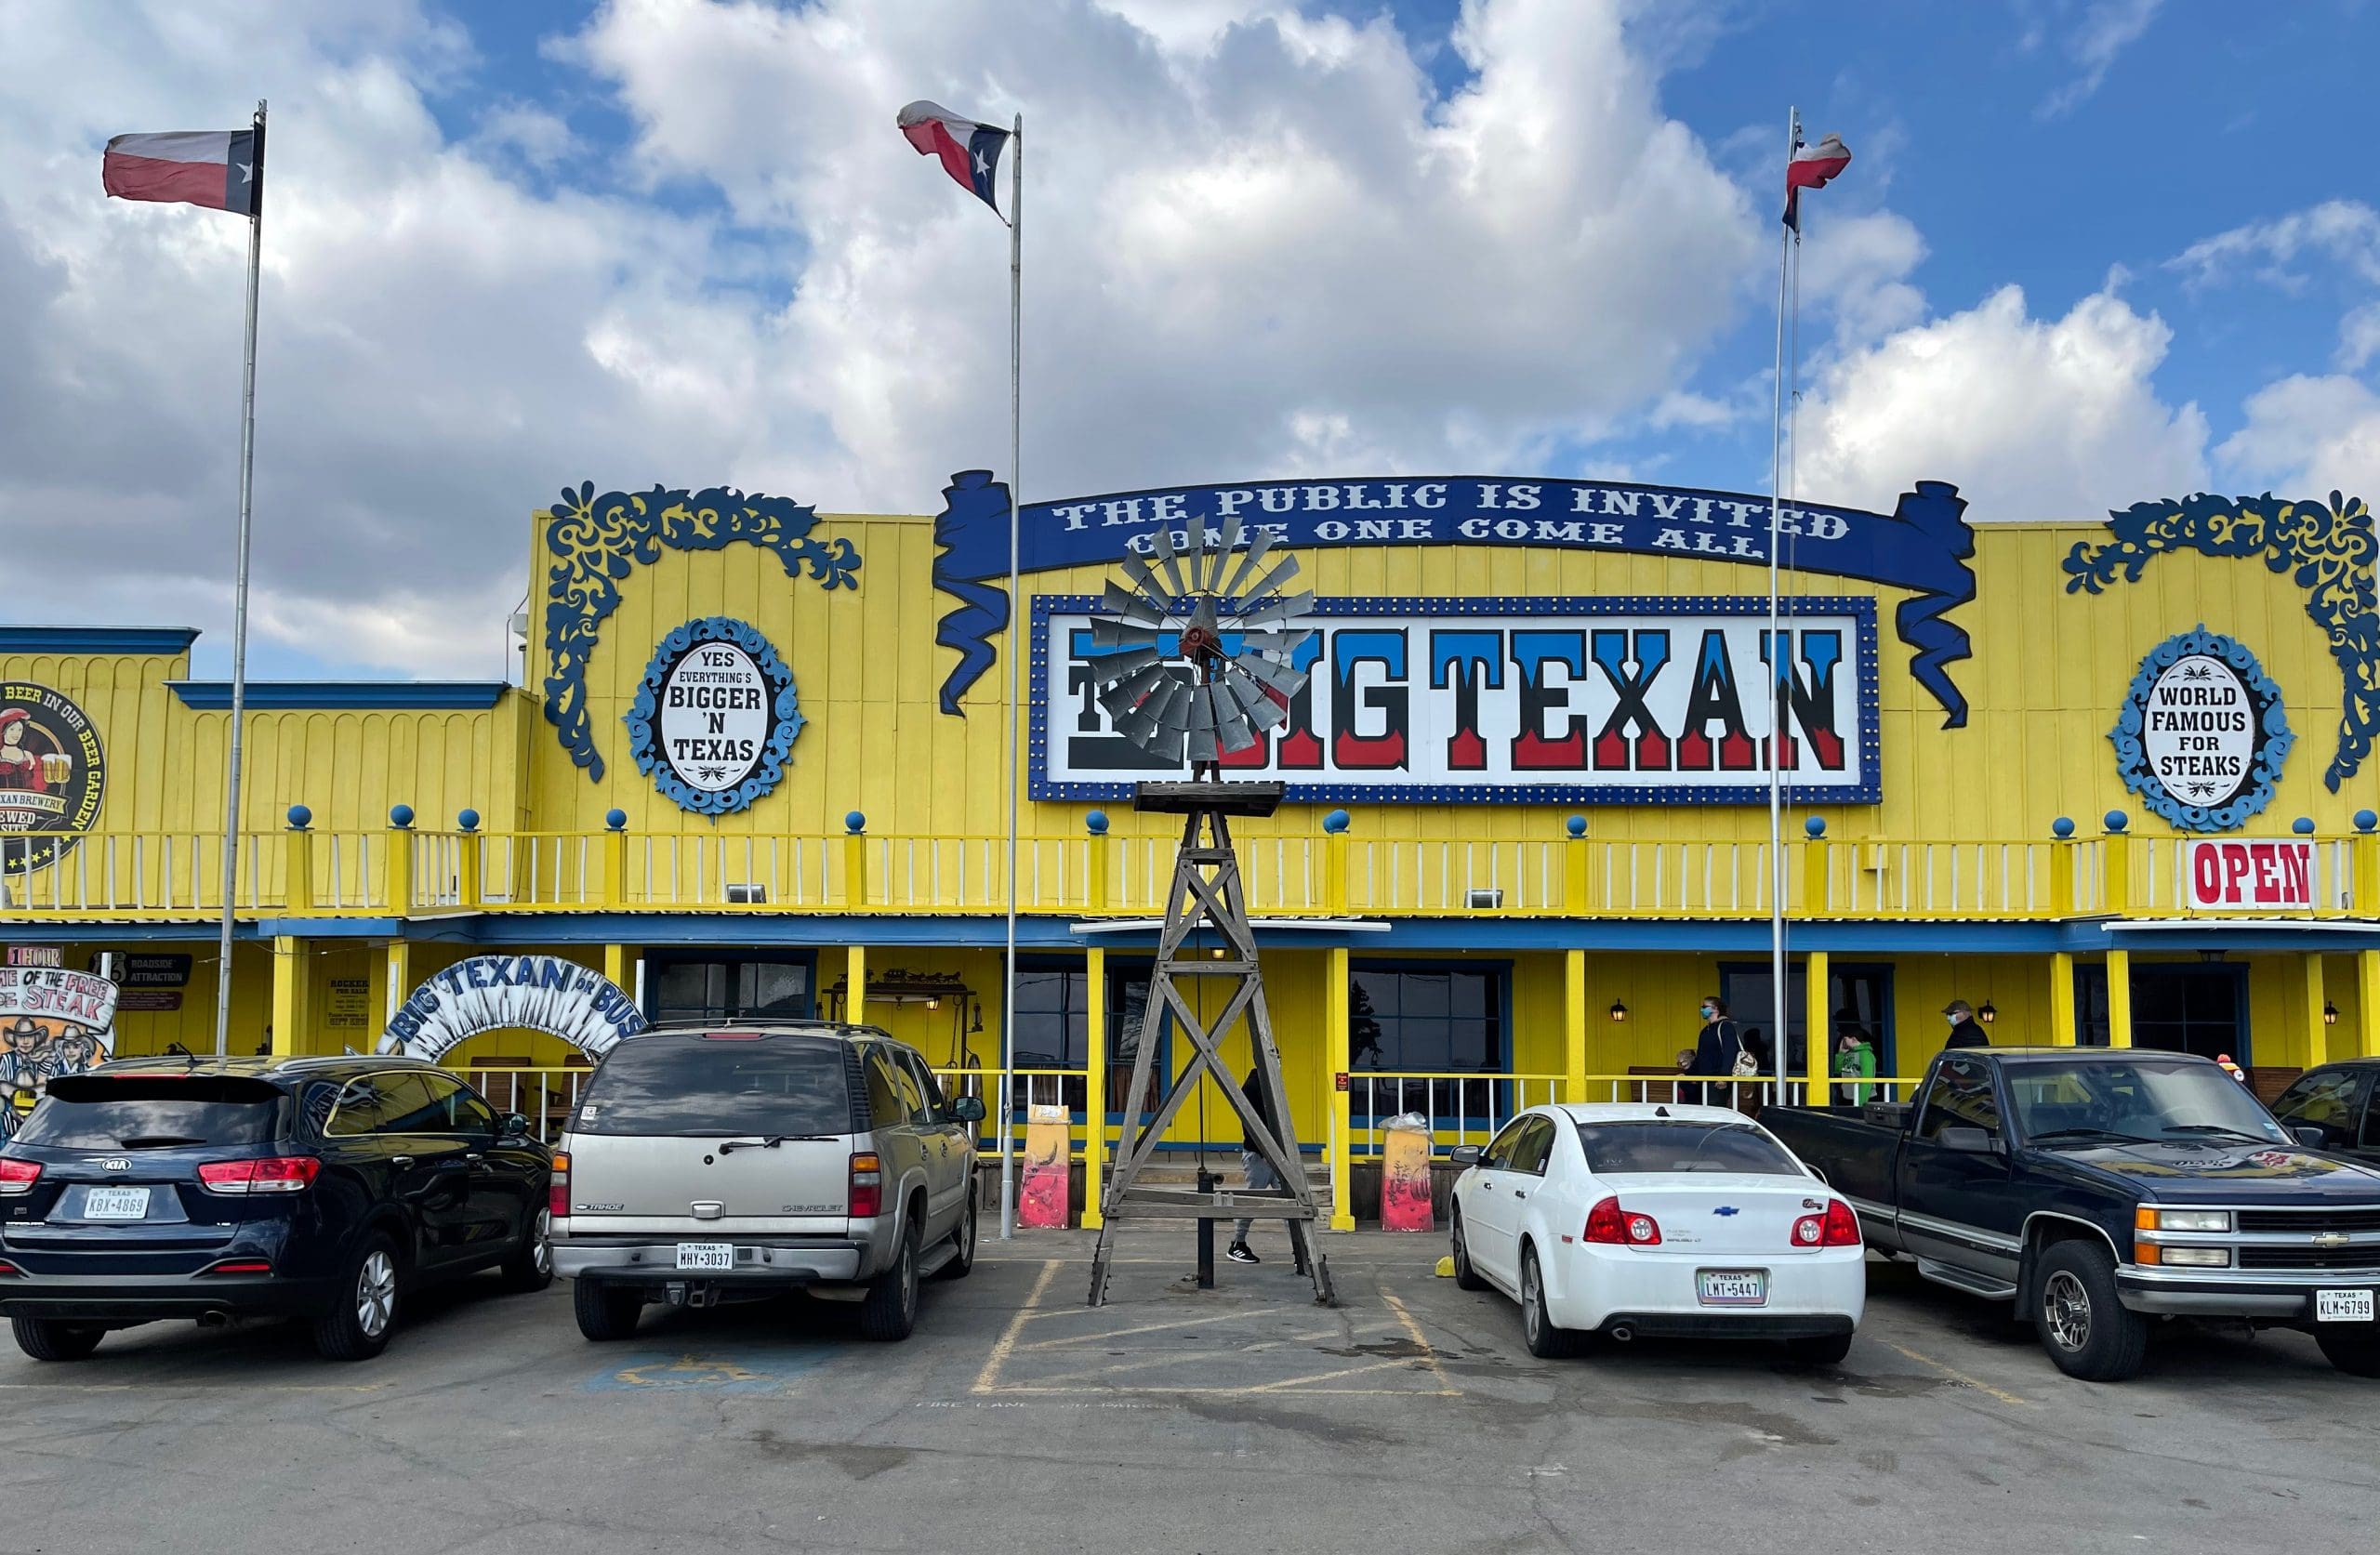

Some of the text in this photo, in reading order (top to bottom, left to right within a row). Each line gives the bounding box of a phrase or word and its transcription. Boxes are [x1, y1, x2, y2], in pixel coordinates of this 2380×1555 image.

[1051, 483, 1851, 540] THE PUBLIC IS INVITED
[1313, 519, 1434, 540] ONE
[1457, 518, 1624, 544] COME
[1651, 527, 1765, 559] ALL
[701, 652, 734, 667] YES
[680, 671, 752, 684] EVERYTHING'S
[669, 686, 760, 710] BIGGER
[1429, 628, 1845, 771] TEXAN
[2158, 687, 2237, 706] WORLD
[2151, 711, 2246, 731] FAMOUS
[674, 739, 753, 761] TEXAS
[2178, 737, 2220, 751] FOR
[5, 686, 101, 831] BEER IN OUR BEER GARDEN
[2161, 756, 2241, 777] STEAKS
[0, 795, 62, 810] XAN BREWERY
[0, 810, 35, 824] EWED
[0, 824, 29, 832] SITE
[2194, 842, 2310, 903] OPEN
[12, 948, 61, 966] 1 HOUR
[0, 969, 18, 987] ME
[23, 970, 42, 985] OF
[46, 971, 64, 988] THE
[66, 974, 110, 1001] FREE
[130, 972, 183, 982] ATTRACTION
[330, 980, 369, 988] ROCKER
[22, 985, 105, 1021] STEAK
[389, 957, 647, 1043] BIG TEXAN OR BUS
[105, 1160, 126, 1170] KIA
